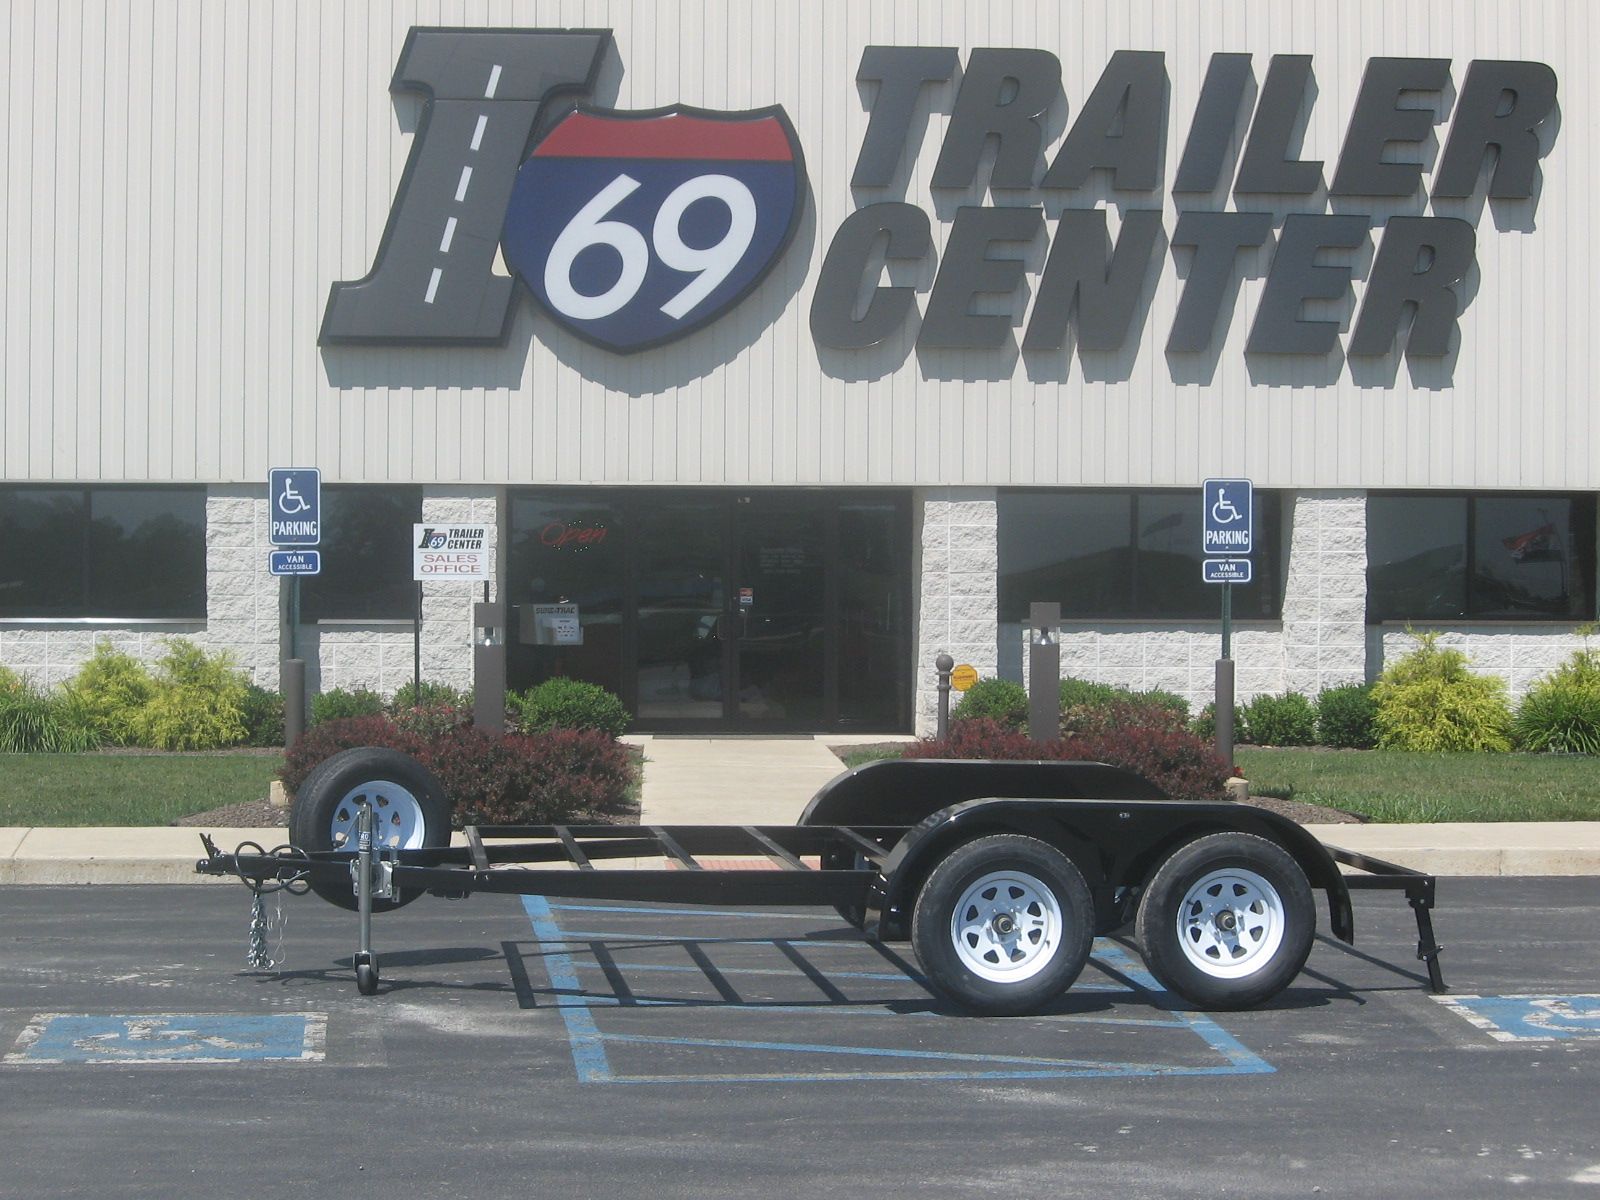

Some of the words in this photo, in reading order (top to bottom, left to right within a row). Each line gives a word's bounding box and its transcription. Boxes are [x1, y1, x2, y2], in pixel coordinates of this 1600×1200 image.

[850, 45, 1558, 201] TRAILER
[317, 26, 614, 348] I
[544, 173, 758, 320] 69
[809, 201, 1478, 358] CENTER
[273, 521, 317, 536] PARKING
[449, 528, 484, 538] TRAILER
[430, 536, 444, 547] 69
[1206, 530, 1249, 545] PARKING
[447, 539, 482, 549] CENTER
[286, 555, 304, 563] VAN
[424, 554, 478, 563] SALES
[420, 564, 481, 573] OFFICE
[1218, 563, 1236, 571] VAN
